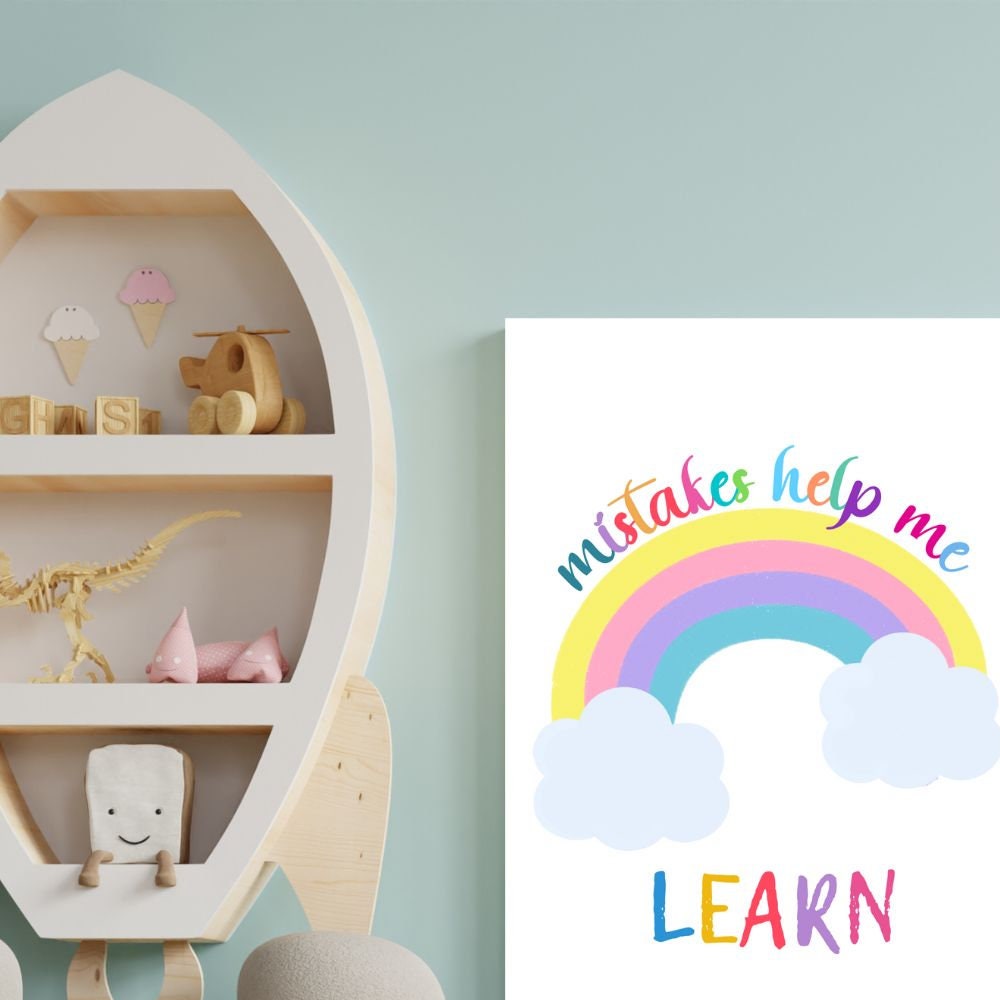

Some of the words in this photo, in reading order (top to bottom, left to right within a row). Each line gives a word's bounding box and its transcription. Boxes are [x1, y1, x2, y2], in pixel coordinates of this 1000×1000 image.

[103, 400, 130, 434] S
[557, 454, 755, 591] mistakes
[772, 445, 882, 530] help
[893, 505, 970, 572] me
[653, 869, 895, 954] LEARN
